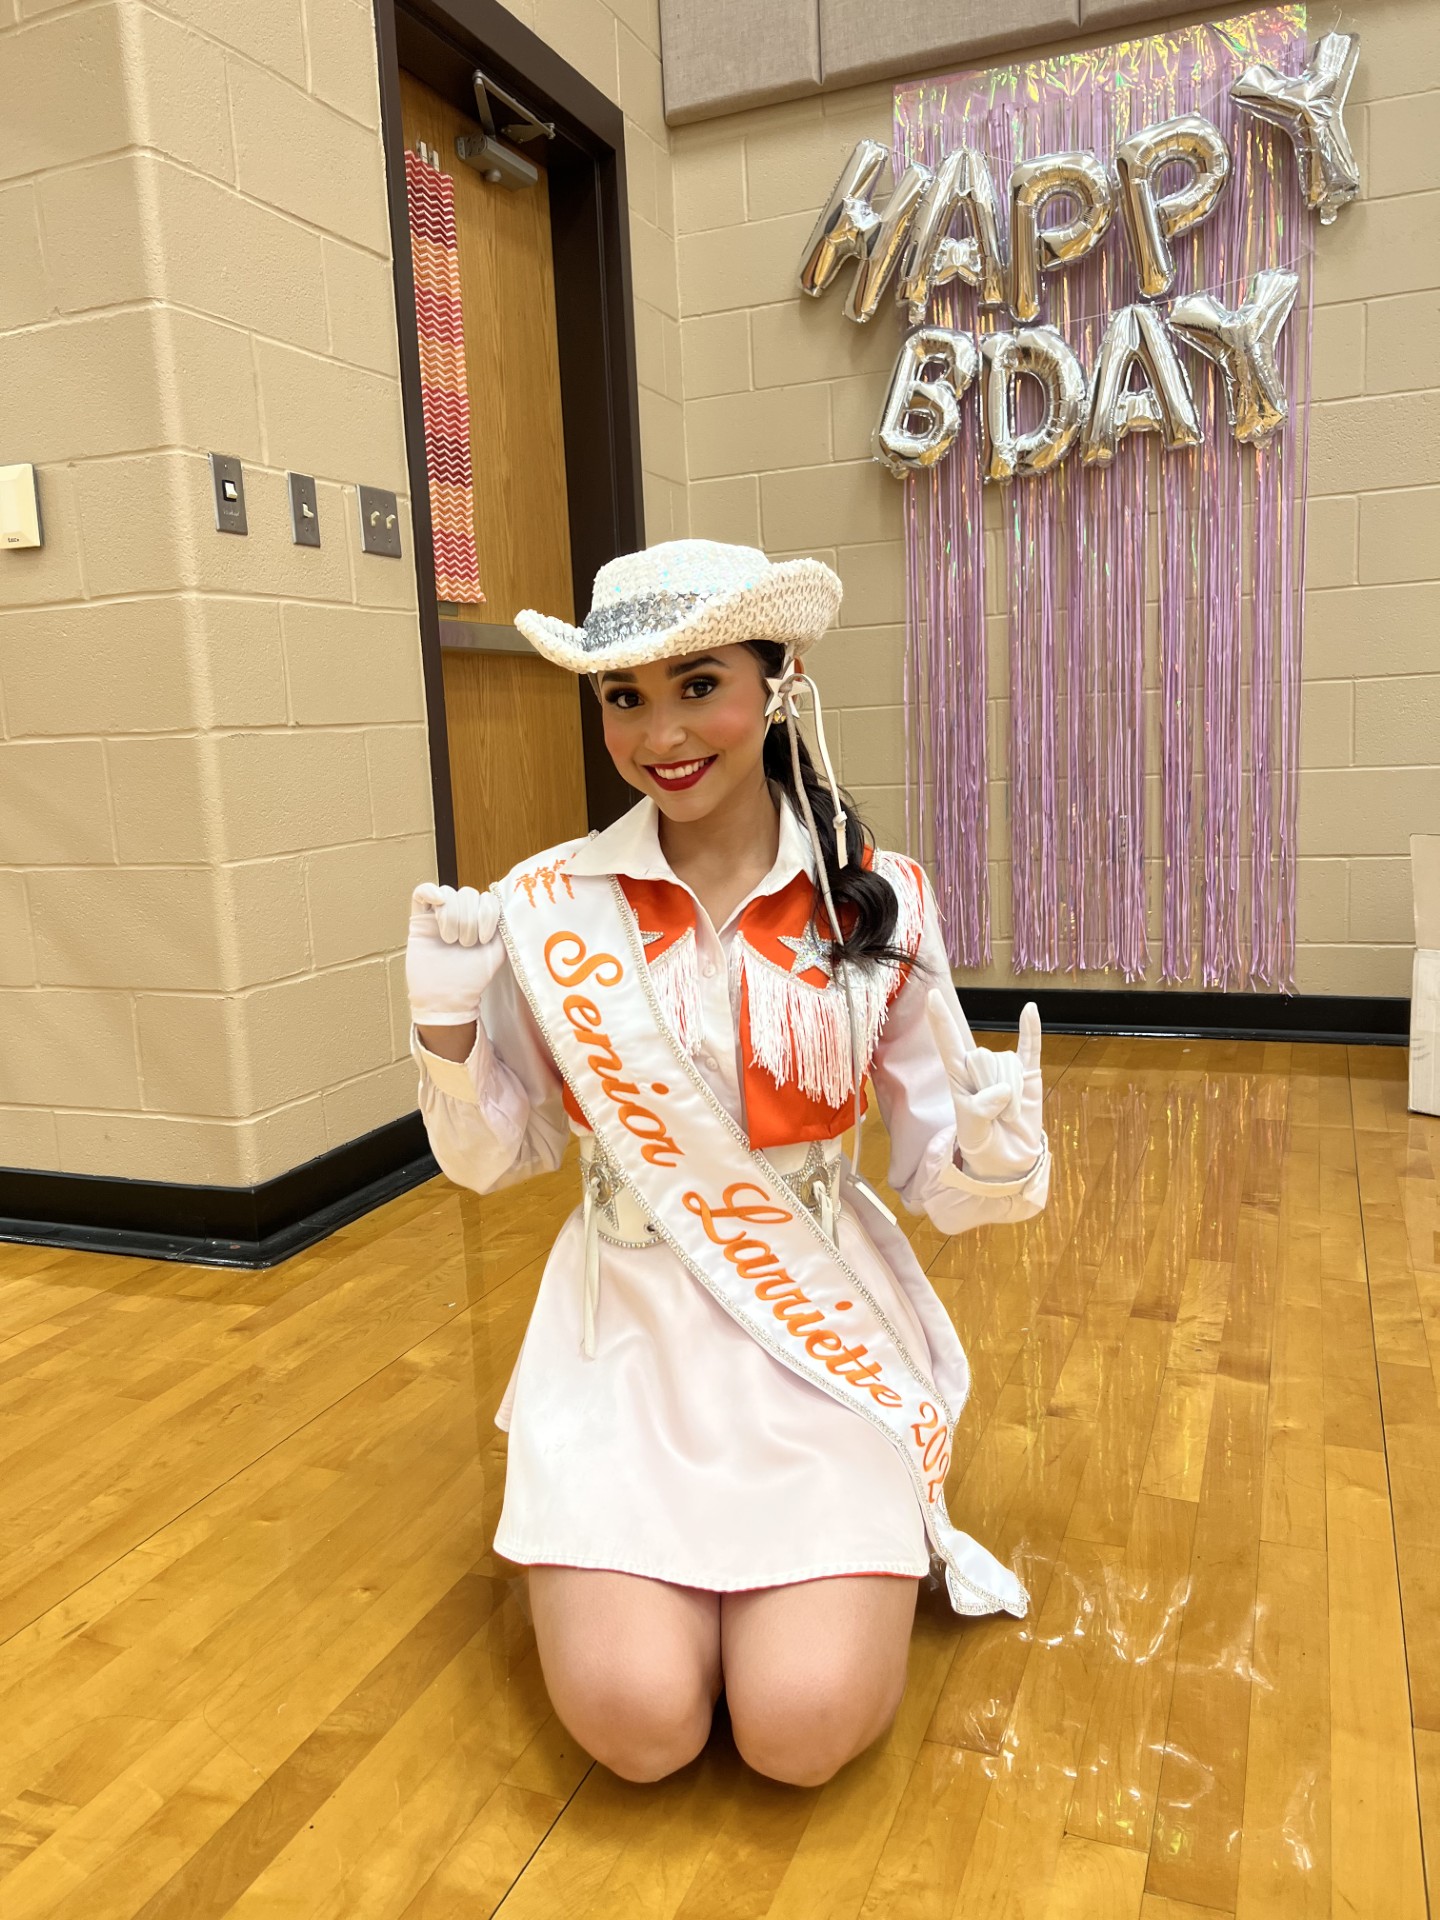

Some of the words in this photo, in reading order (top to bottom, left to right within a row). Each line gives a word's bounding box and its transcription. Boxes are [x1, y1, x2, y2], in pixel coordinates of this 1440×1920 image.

[800, 32, 1361, 323] HAPPY
[872, 268, 1299, 484] BDAY
[544, 930, 685, 1168] Senior
[682, 1182, 902, 1407] Larriette
[911, 1401, 949, 1504] 202
